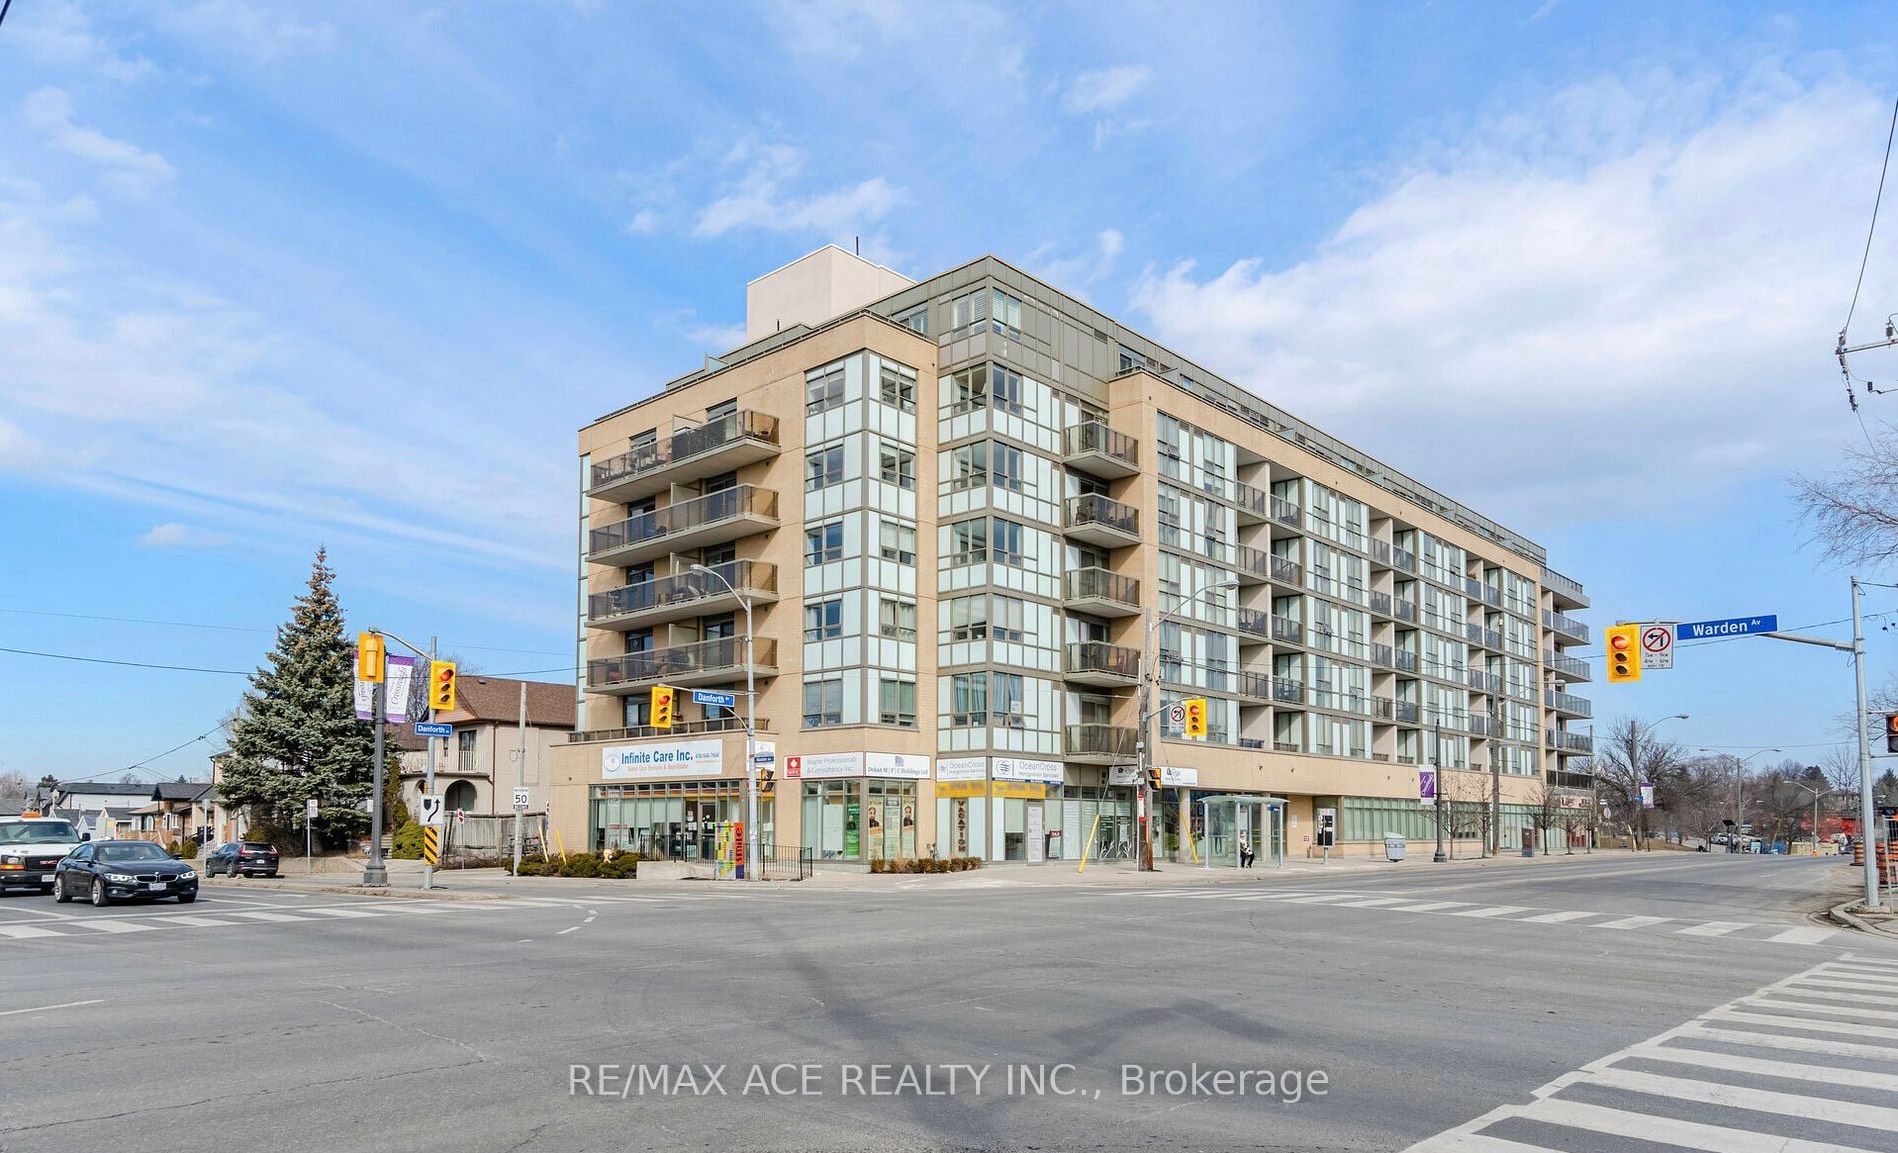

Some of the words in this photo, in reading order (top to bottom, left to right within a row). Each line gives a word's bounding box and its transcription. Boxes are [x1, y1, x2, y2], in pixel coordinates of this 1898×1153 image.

[1693, 622, 1748, 636] Warden
[698, 693, 725, 703] Danforth
[418, 725, 445, 733] Danforth
[621, 751, 651, 764] Infinite
[653, 751, 674, 762] Care
[676, 749, 694, 761] Inc.
[949, 760, 985, 769] OceanCross
[1019, 760, 1058, 772] OceanCross
[515, 794, 527, 803] 50
[957, 800, 966, 852] VACATION
